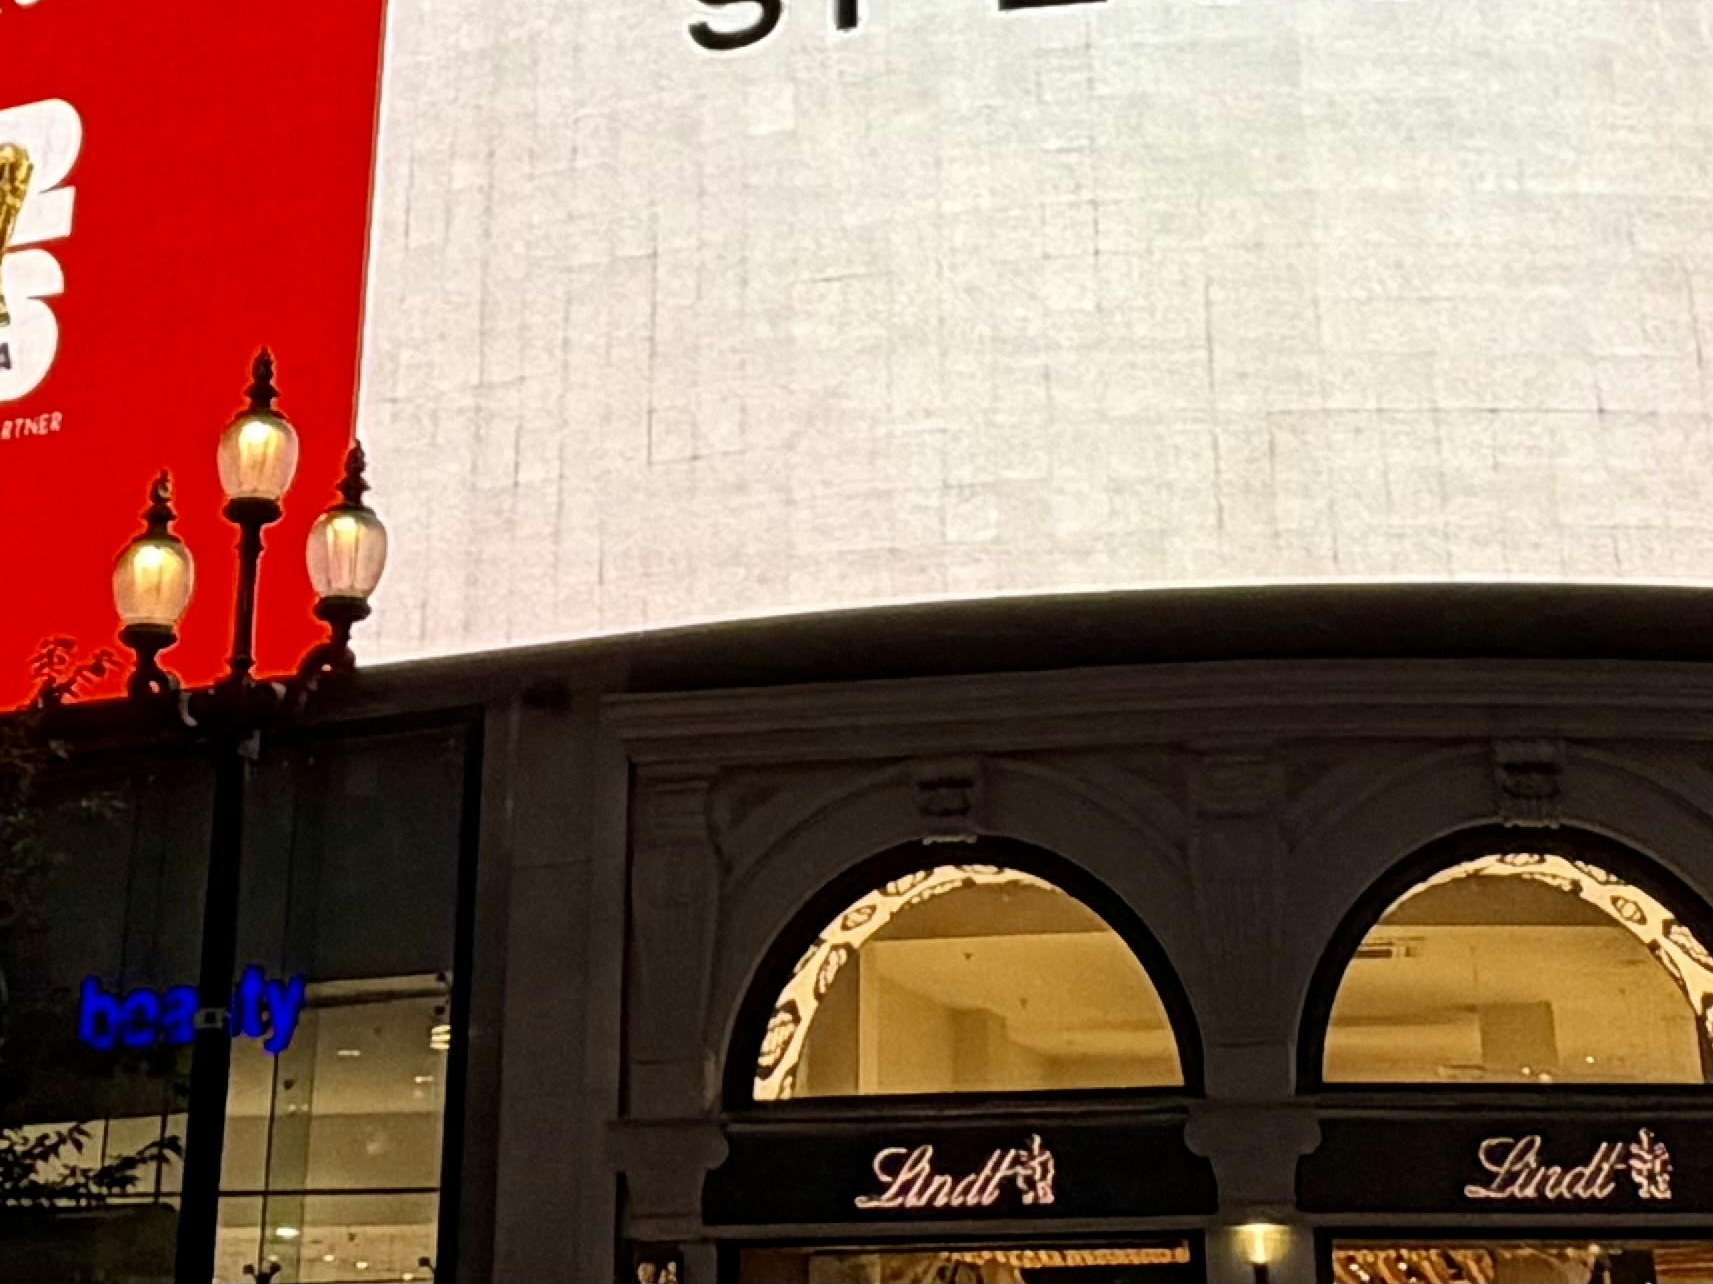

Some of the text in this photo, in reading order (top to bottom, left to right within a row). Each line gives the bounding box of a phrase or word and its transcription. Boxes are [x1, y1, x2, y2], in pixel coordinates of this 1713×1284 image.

[79, 964, 306, 1055] beaty
[854, 1144, 1021, 1210] Lindt
[1464, 1134, 1626, 1200] Lindt
